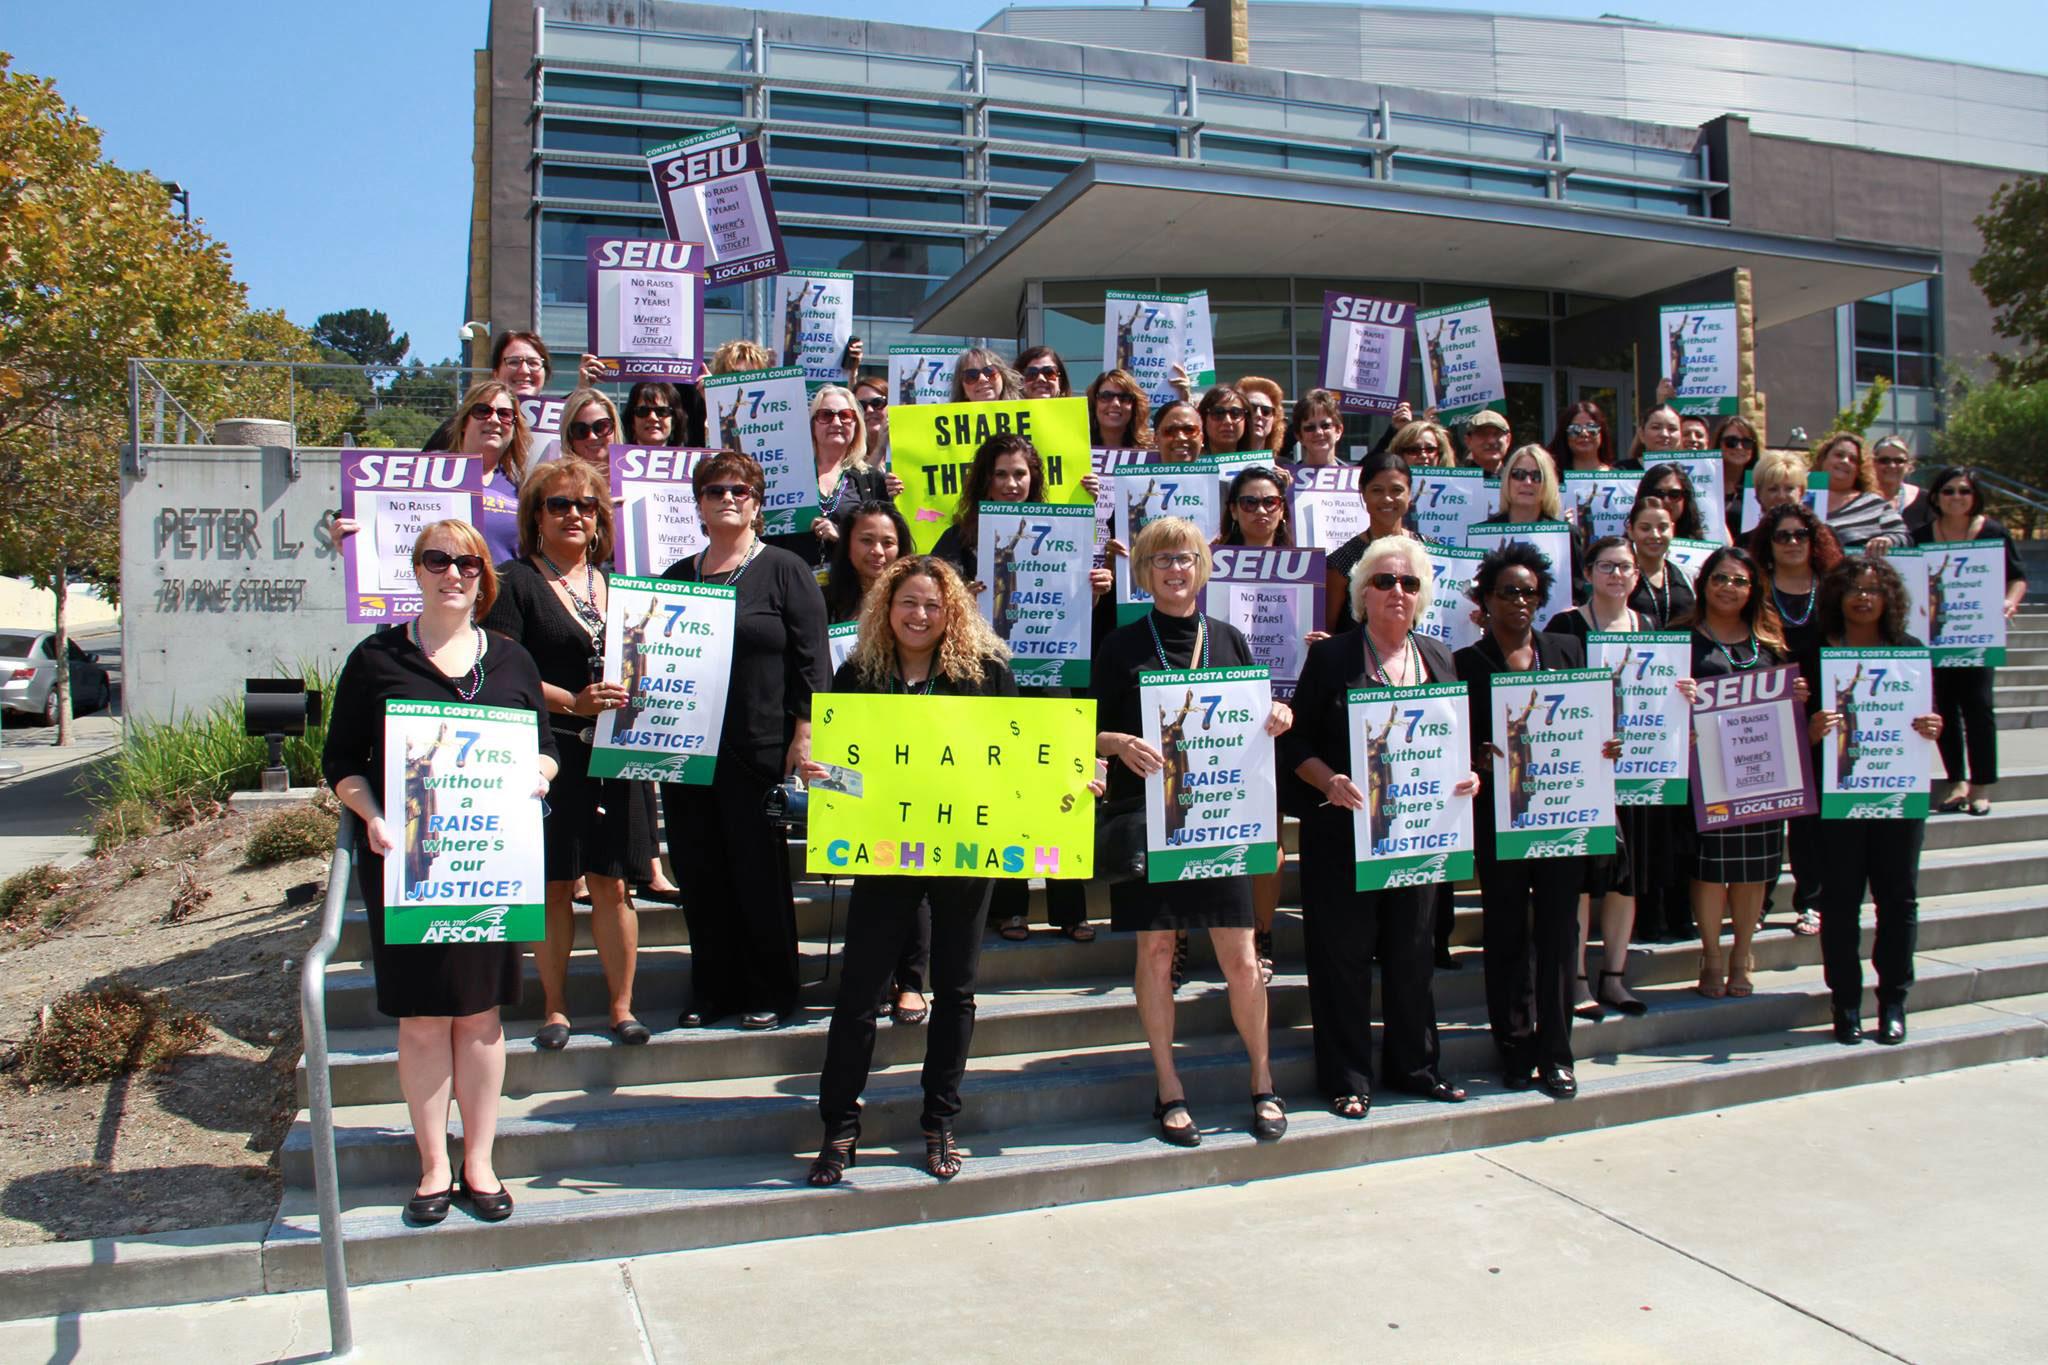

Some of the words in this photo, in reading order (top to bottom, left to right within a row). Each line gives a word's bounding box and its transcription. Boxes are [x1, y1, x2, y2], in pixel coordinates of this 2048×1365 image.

[646, 143, 677, 157] CONTRA
[679, 136, 704, 147] COSTA
[705, 126, 736, 139] COURTS
[667, 144, 747, 188] SEIU
[599, 241, 692, 269] SEIU
[716, 264, 750, 279] LOCAL
[753, 258, 775, 270] 1021
[631, 278, 644, 286] NO
[647, 279, 673, 288] RAISES
[642, 298, 670, 306] YEARS!
[812, 285, 826, 307] 7
[1161, 295, 1188, 303] COURTS
[1332, 296, 1406, 324] SEIU
[1144, 308, 1159, 331] 7
[1154, 320, 1176, 329] YRS.
[1692, 317, 1705, 335] 7
[1448, 319, 1461, 340] 7
[1458, 326, 1480, 335] YRS.
[626, 364, 664, 373] LOCAL
[668, 365, 692, 374] 1021
[705, 376, 737, 386] CONTRA
[739, 373, 767, 382] COSTA
[769, 368, 802, 378] COURTS
[927, 362, 944, 385] 7
[748, 390, 766, 419] 7
[761, 401, 791, 413] YRS.
[1345, 396, 1374, 408] LOCAL
[1377, 401, 1397, 410] 1021
[355, 455, 468, 488] SEIU
[1115, 467, 1151, 475] CONTRA
[1152, 465, 1182, 473] COSTA
[1183, 464, 1218, 472] COURTS
[1565, 472, 1599, 480] CONTRA
[1601, 471, 1626, 479] COSTA
[653, 494, 666, 502] NO
[668, 495, 697, 504] RAISES
[1159, 483, 1178, 510] 7
[1174, 495, 1203, 506] YRS.
[1430, 484, 1445, 508] 7
[1441, 495, 1467, 505] YRS.
[1601, 486, 1617, 509] 7
[390, 501, 406, 510] NO
[409, 501, 441, 511] RAISES
[980, 504, 1019, 513] CONTRA
[1022, 505, 1053, 514] COSTA
[1056, 507, 1094, 515] COURTS
[161, 507, 262, 549] PETER
[657, 515, 663, 523] 7
[664, 516, 694, 524] YEARS!
[658, 534, 696, 545] WHERE'S
[1030, 525, 1051, 556] 7
[1045, 540, 1077, 552] YRS.
[1006, 560, 1067, 573] without
[1210, 550, 1312, 580] SEIU
[193, 579, 232, 601] PINE
[239, 579, 307, 601] STREET
[610, 578, 653, 590] CONTRA
[655, 582, 690, 593] COSTA
[693, 586, 735, 598] COURTS
[1241, 593, 1254, 601] NO
[1257, 594, 1287, 602] RAISES
[359, 608, 386, 617] SEIU
[663, 604, 686, 637] 7
[679, 621, 714, 636] YRS.
[1252, 615, 1283, 623] YEARS!
[1025, 625, 1051, 635] our
[1588, 634, 1625, 642] CONTRA
[1626, 634, 1655, 642] COSTA
[1657, 634, 1691, 642] COURTS
[636, 642, 702, 658] without
[1822, 650, 1859, 658] CONTRA
[1860, 650, 1893, 658] COSTA
[1894, 650, 1930, 658] COURTS
[1636, 652, 1655, 681] 7
[1649, 665, 1677, 677] YRS.
[1141, 673, 1185, 684] CONTRA
[1188, 671, 1224, 682] COSTA
[1226, 669, 1269, 679] COURTS
[1493, 675, 1534, 685] CONTRA
[1536, 673, 1568, 683] COSTA
[1571, 671, 1612, 680] COURTS
[1868, 668, 1887, 696] 7
[1883, 680, 1913, 692] YRS.
[1350, 692, 1391, 702] CONTRA
[1393, 689, 1426, 698] COSTA
[1428, 686, 1468, 696] COURTS
[1615, 685, 1668, 696] without
[1693, 669, 1786, 712] SEIU
[631, 695, 696, 711] where's
[1544, 694, 1565, 726] 7
[1560, 707, 1593, 720] YRS.
[387, 703, 441, 716] CONTRA
[443, 706, 485, 719] COSTA
[488, 708, 537, 724] COURTS
[650, 714, 680, 726] our
[1200, 695, 1222, 731] 7
[1217, 709, 1254, 724] YRS.
[1403, 709, 1424, 743] 7
[1418, 722, 1452, 737] YRS.
[611, 729, 705, 749] JUSTICE?
[1176, 734, 1244, 752] without
[1520, 729, 1584, 745] without
[455, 731, 481, 768] 7
[474, 749, 517, 765] YRS.
[847, 743, 1051, 766] SHARE
[1381, 747, 1443, 764] without
[1630, 746, 1654, 755] our
[423, 774, 504, 790] without
[616, 766, 685, 783] AFSCME
[1522, 777, 1585, 793] where's
[1178, 787, 1246, 805] where's
[1544, 795, 1570, 806] our
[899, 801, 990, 826] THE
[1202, 807, 1231, 819] our
[1382, 799, 1445, 816] where's
[1735, 802, 1774, 816] LOCAL
[1778, 797, 1804, 808] 1021
[1404, 817, 1431, 829] our
[1511, 809, 1599, 828] JUSTICE?
[1707, 815, 1729, 824] SEIU
[1167, 822, 1262, 845] JUSTICE?
[422, 836, 505, 853] where's
[1371, 833, 1459, 855] JUSTICE?
[1524, 843, 1588, 859] AFSCME
[449, 859, 486, 872] our
[1178, 862, 1248, 880] AFSCME
[1383, 869, 1447, 889] AFSCME
[407, 880, 523, 900] JUSTICE?
[421, 925, 508, 943] AFSCME
